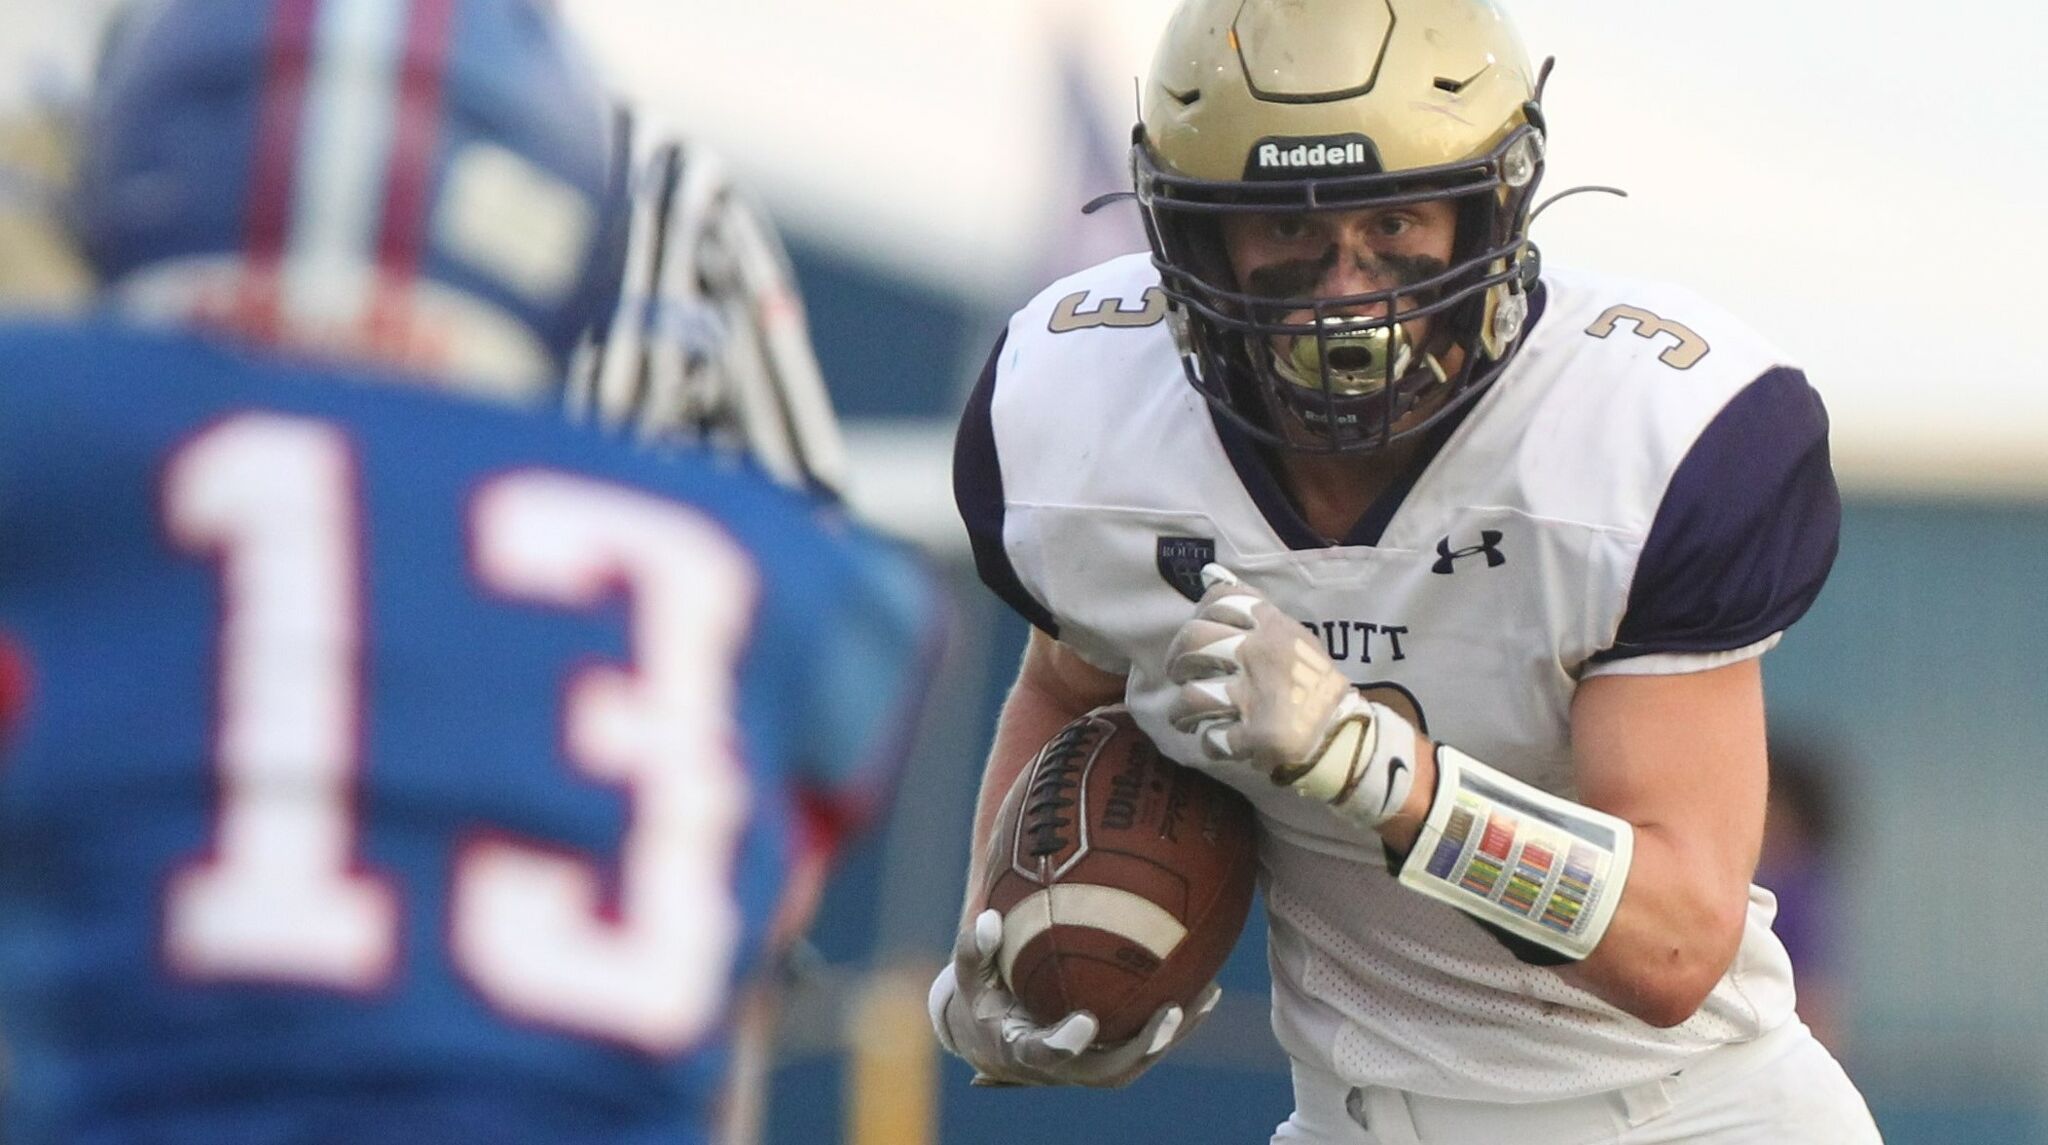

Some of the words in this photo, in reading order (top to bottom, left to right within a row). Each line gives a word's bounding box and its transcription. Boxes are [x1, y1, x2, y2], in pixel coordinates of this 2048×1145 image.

[1259, 143, 1364, 166] Riddell
[1048, 286, 1168, 333] 3
[1584, 304, 1710, 370] 3
[1304, 409, 1357, 424] Ridell
[1162, 544, 1210, 559] ROUTT
[159, 408, 758, 1060] 13
